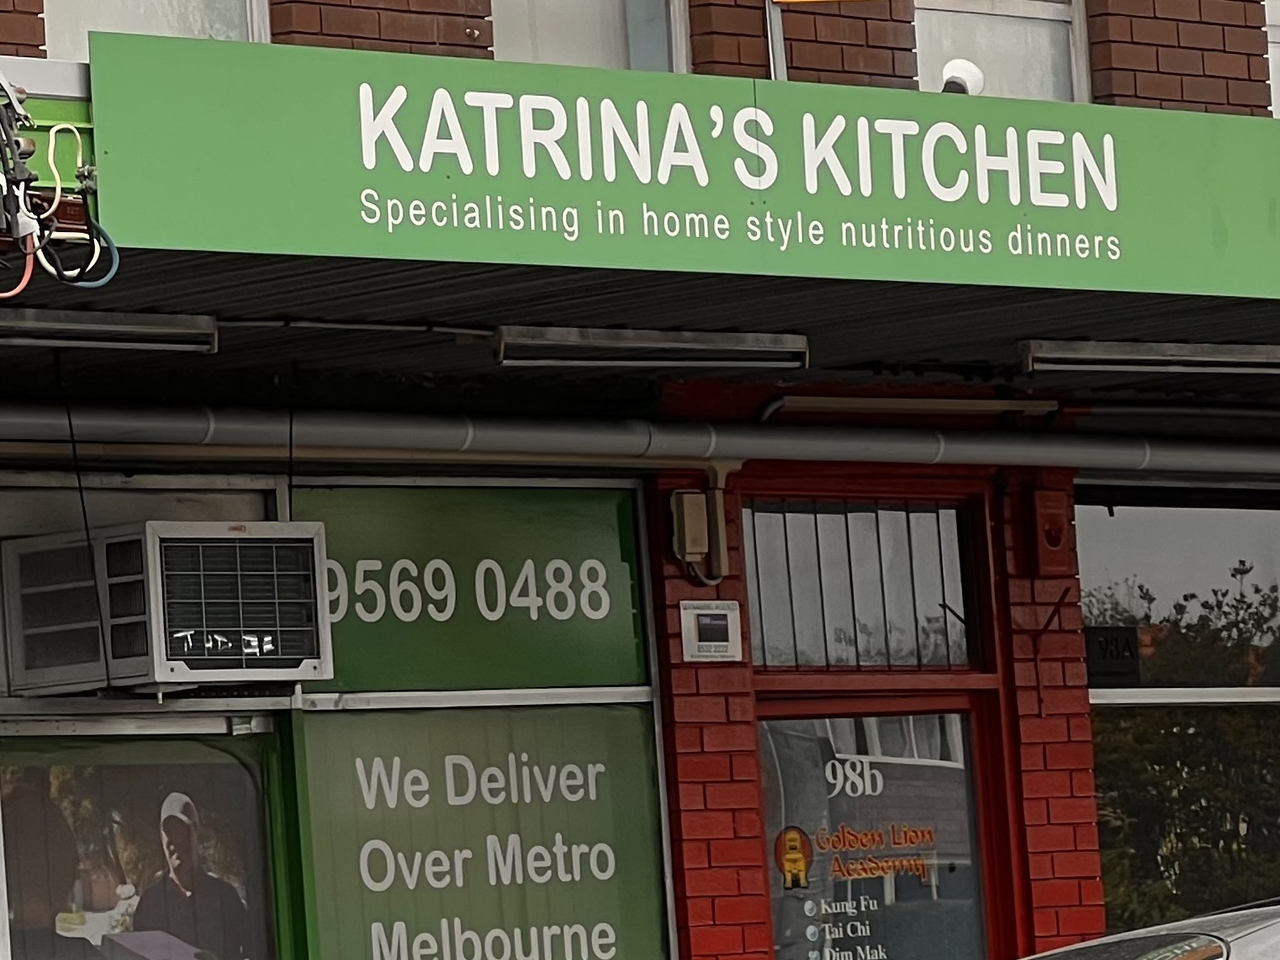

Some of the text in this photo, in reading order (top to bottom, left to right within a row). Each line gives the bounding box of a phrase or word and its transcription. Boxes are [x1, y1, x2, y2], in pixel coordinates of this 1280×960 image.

[359, 82, 1118, 212] KATRINA'S KITCHEN
[360, 188, 1121, 260] Specialising in home style nutritious dinners
[327, 558, 610, 623] 9569 0488
[355, 752, 605, 810] We Deliver
[825, 759, 884, 798] 98b
[815, 822, 935, 853] Golden Lion
[359, 832, 616, 892] Over Metro
[829, 854, 928, 883] Academy
[820, 895, 878, 916] Kung Fu
[821, 921, 871, 940] Tai Chi
[856, 944, 887, 960] Mak
